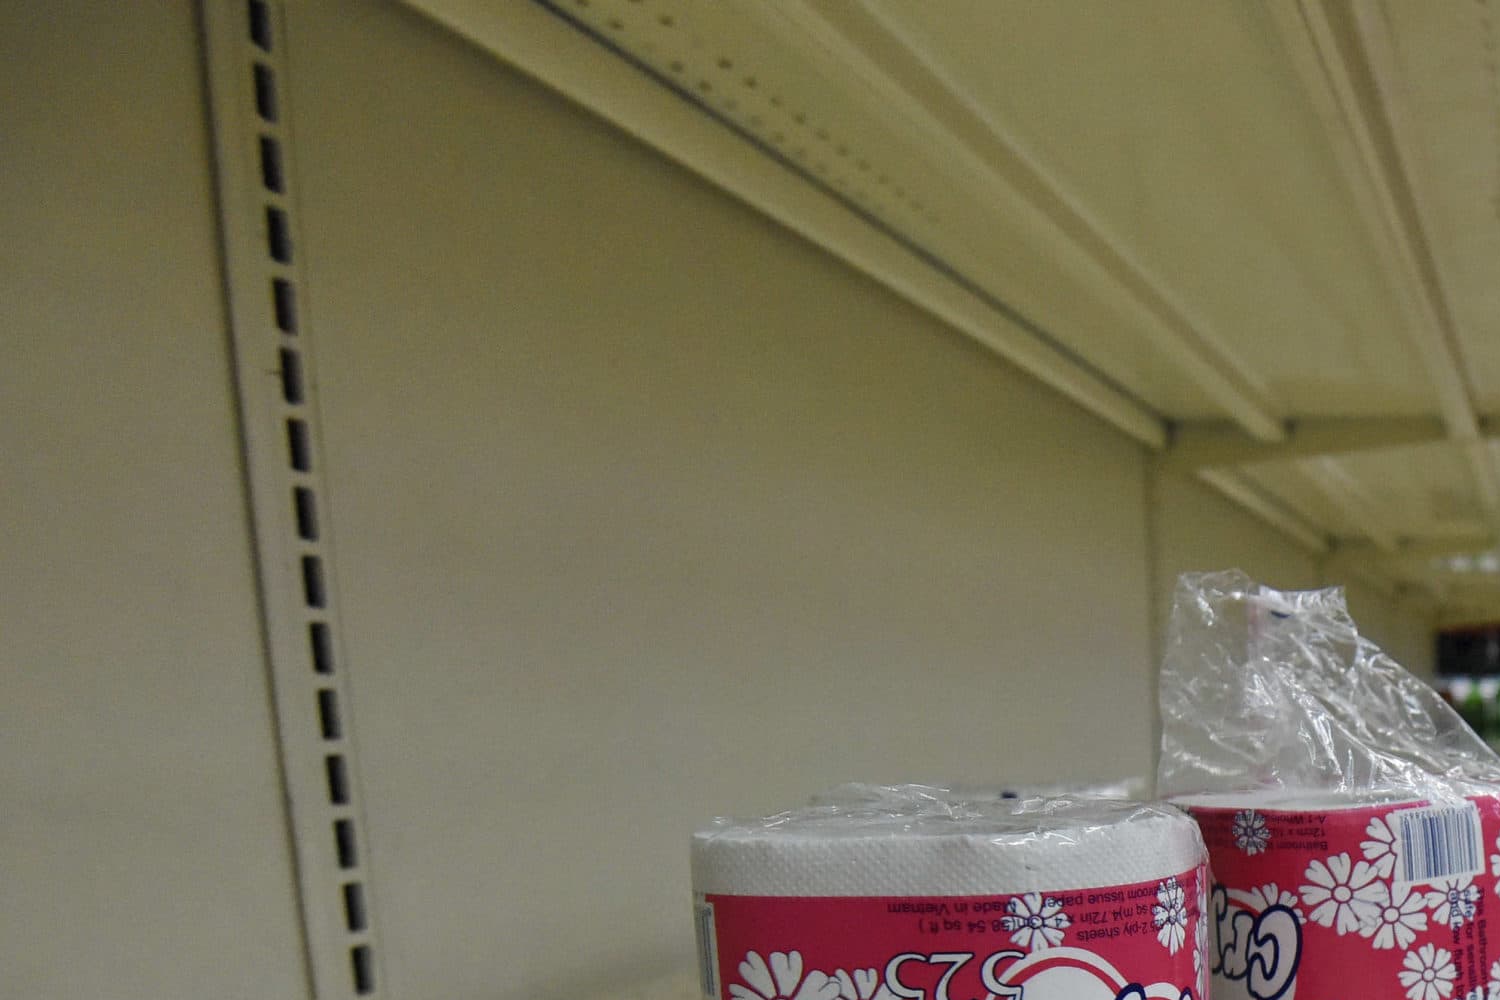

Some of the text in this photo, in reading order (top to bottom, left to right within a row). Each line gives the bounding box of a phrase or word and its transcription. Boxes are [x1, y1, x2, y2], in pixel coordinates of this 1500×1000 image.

[1087, 892, 1126, 906] tissue
[887, 903, 950, 915] Vietnam
[954, 903, 968, 915] in
[973, 902, 1017, 914] Made
[1076, 927, 1121, 943] sheets
